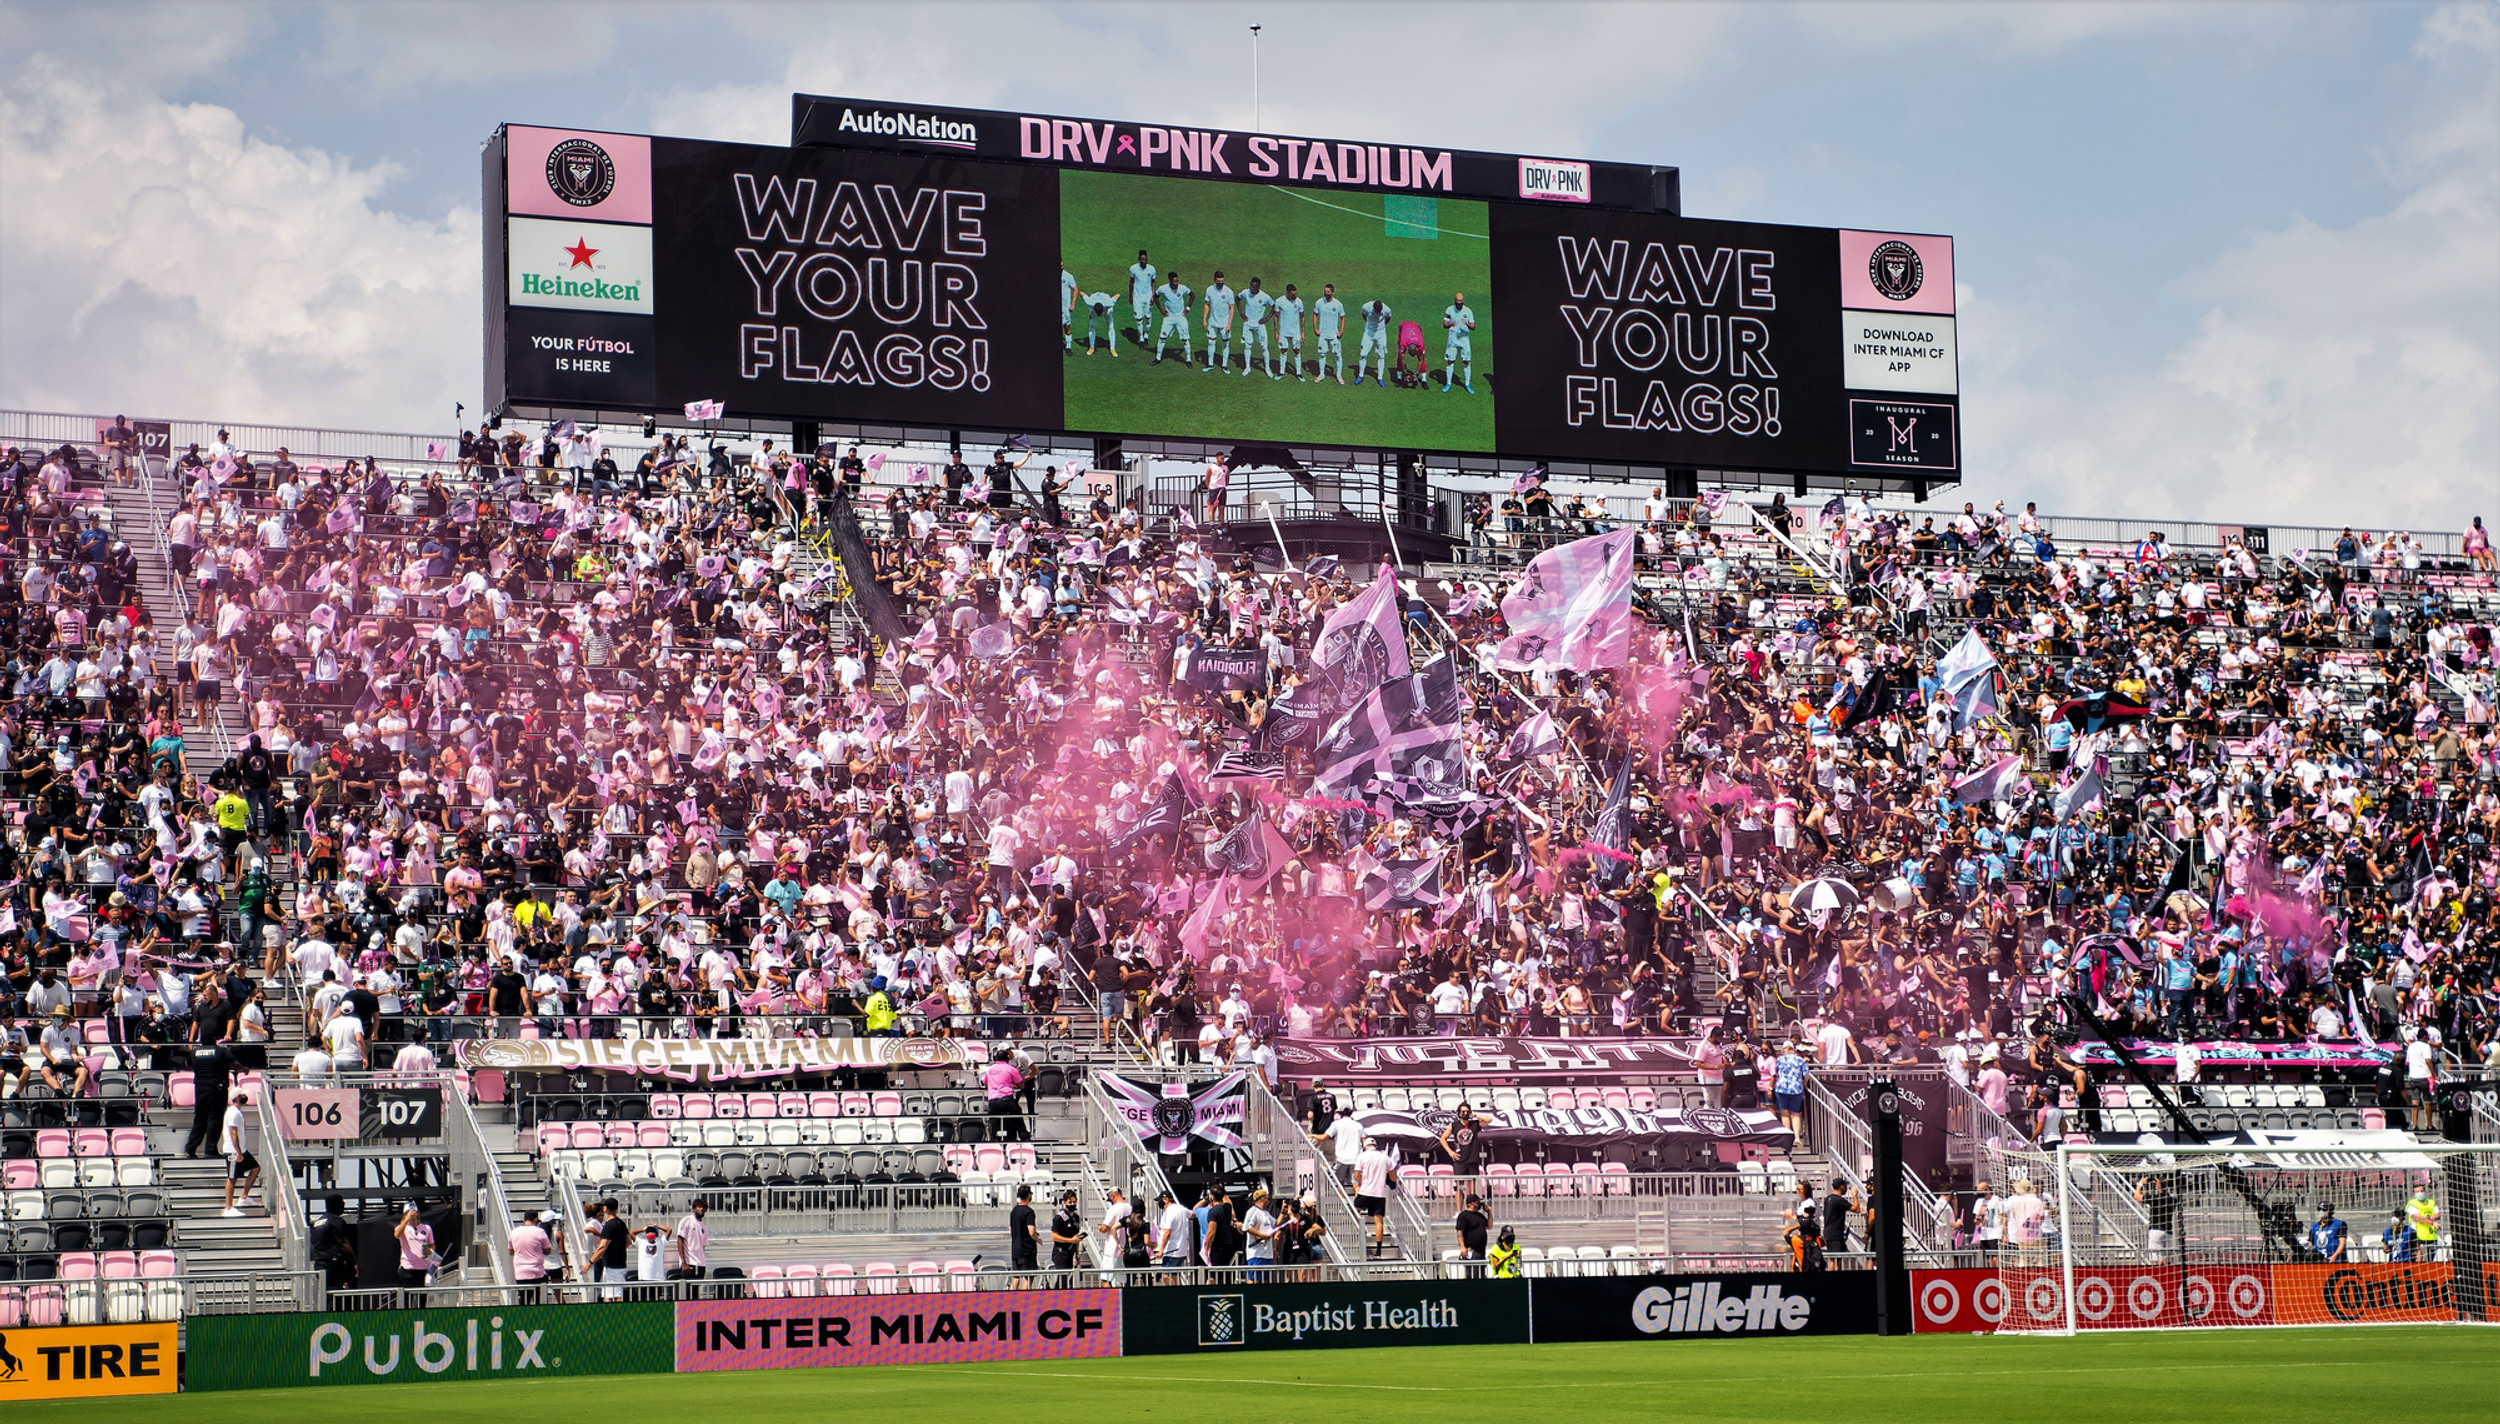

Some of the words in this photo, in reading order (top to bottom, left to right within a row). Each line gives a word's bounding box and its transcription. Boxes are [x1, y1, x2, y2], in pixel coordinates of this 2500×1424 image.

[838, 108, 977, 137] AutoNation
[567, 155, 594, 163] MIAMI
[1020, 117, 1114, 164] DRV
[1140, 126, 1232, 174] PNK
[1249, 136, 1453, 191] STADIUM
[1526, 167, 1552, 190] DRV
[1558, 170, 1583, 192] PNK
[734, 173, 987, 257] WAVE
[1885, 255, 1907, 263] MIAMI
[1557, 236, 1776, 311] WAVE
[521, 273, 640, 301] Heineken
[735, 248, 988, 330] YOUR
[531, 336, 574, 351] YOUR
[577, 336, 634, 354] FÚTBOL
[1560, 304, 1779, 379] YOUR
[1863, 328, 1934, 343] DOWNLOAD
[740, 324, 992, 393] FLAGS!
[1854, 343, 1888, 356] INTER
[1890, 346, 1926, 358] MIAMI
[1929, 348, 1945, 359] CF
[556, 357, 569, 370] IS
[573, 359, 611, 373] HERE
[1888, 361, 1911, 372] APP
[1566, 375, 1782, 437] FLAGS!
[1875, 405, 1927, 415] INAUGURAL
[137, 432, 168, 448] 107
[2249, 536, 2265, 548] 111
[228, 803, 235, 814] 8
[555, 1039, 698, 1081] SIEGE
[706, 1038, 884, 1081] MIAMI
[905, 1044, 935, 1052] MIAMI
[293, 1102, 341, 1126] 106
[377, 1101, 426, 1125] 107
[1200, 1102, 1241, 1121] MIAMI
[1321, 1098, 1333, 1114] 8
[1299, 1173, 1314, 1191] 108
[1253, 1302, 1356, 1341] Baptist
[1363, 1299, 1459, 1330] Health
[1632, 1282, 1811, 1334] Gillette
[696, 1317, 852, 1351] INTER
[870, 1311, 1021, 1346] MIAMI
[1037, 1309, 1103, 1340] CF
[309, 1315, 546, 1377] Publix
[37, 1342, 160, 1381] TIRE
